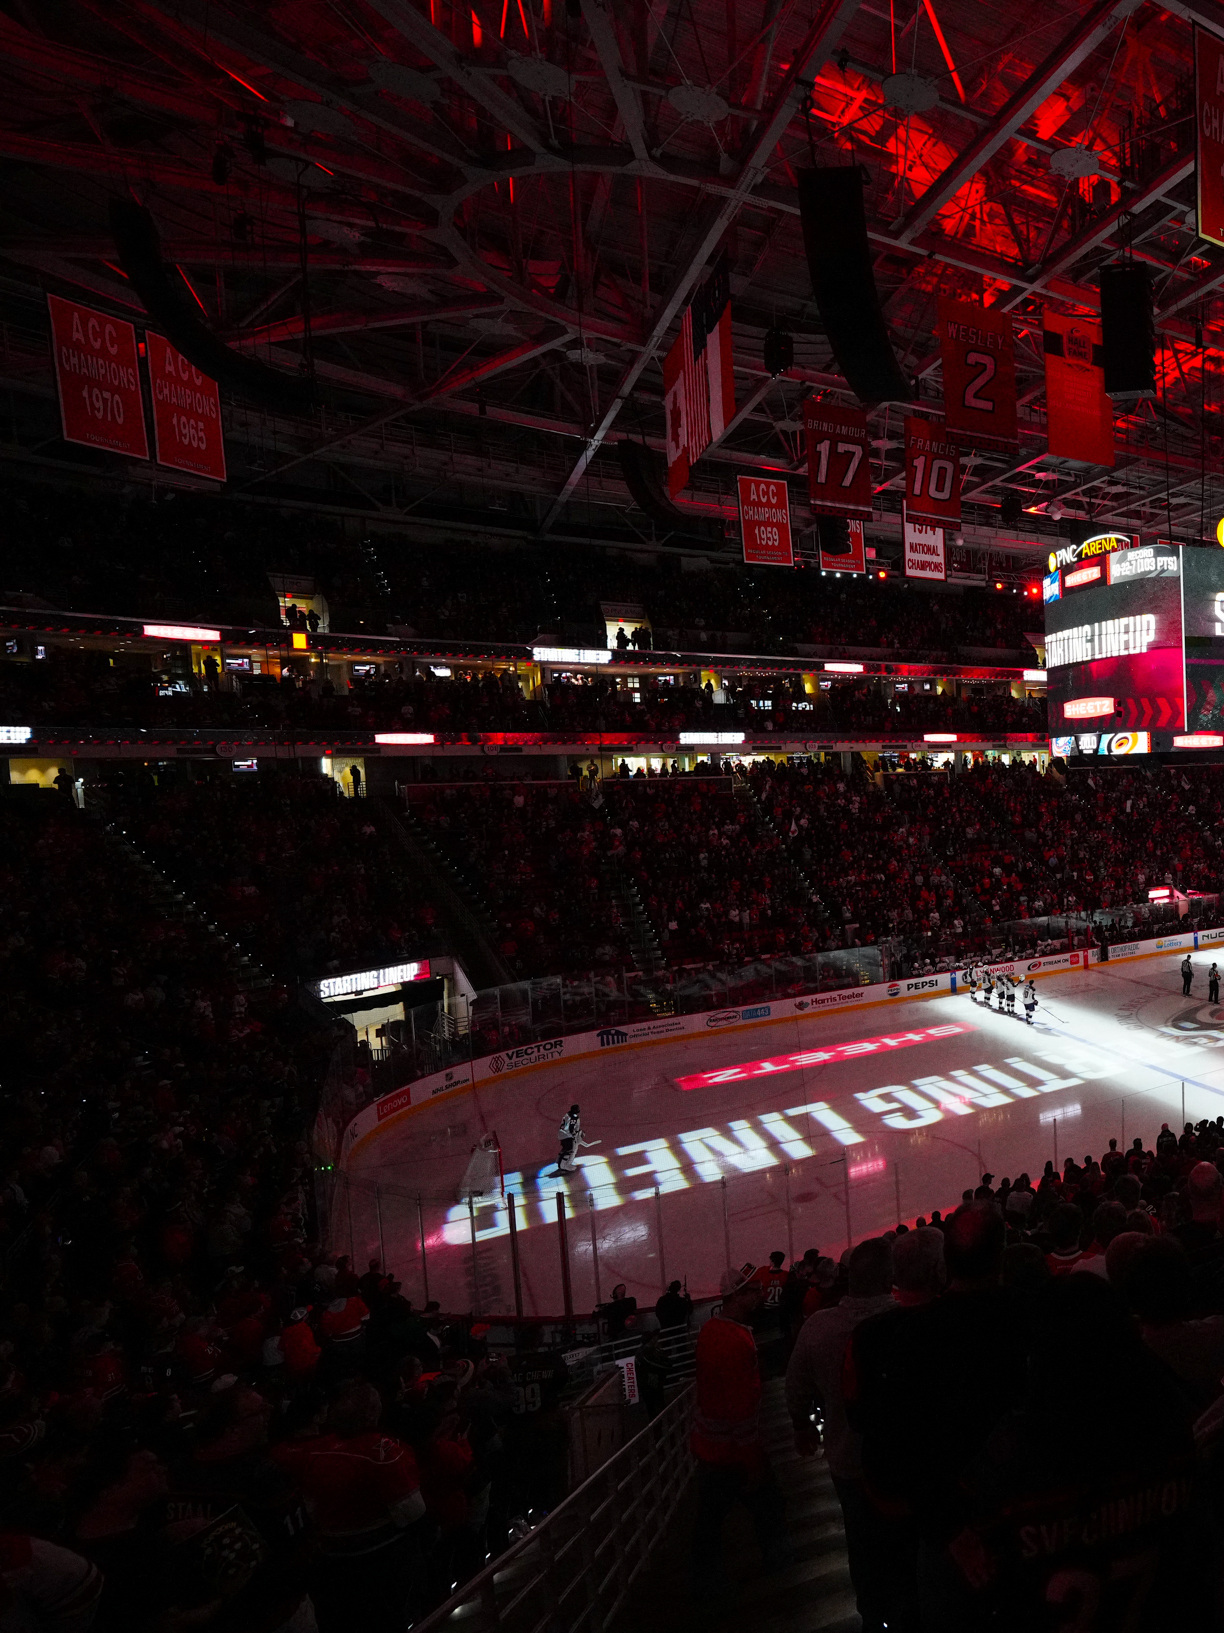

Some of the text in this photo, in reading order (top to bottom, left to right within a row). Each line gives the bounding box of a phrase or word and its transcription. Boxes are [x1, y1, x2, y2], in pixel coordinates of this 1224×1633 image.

[72, 311, 118, 355] ACC
[947, 321, 1005, 351] WESLEY
[61, 346, 136, 391] CHAMPIONS
[964, 351, 996, 413] 2
[81, 384, 124, 425] 1970
[155, 378, 217, 419] CHAMPIONS
[172, 412, 207, 450] 1965
[806, 418, 867, 439] BRIND'AMOUR
[86, 432, 131, 449] TOURNAMENT
[909, 436, 957, 456] FRANCIS
[815, 439, 864, 487] 17
[912, 454, 955, 500] 10
[750, 482, 778, 504] ACC
[743, 505, 788, 524] CHAMPIONS
[755, 525, 779, 546] 1959
[909, 542, 940, 557] NATIONAL
[1055, 536, 1118, 567] PNC ARENA
[1127, 548, 1153, 561] RECORD
[907, 559, 943, 574] CHAMPIONS
[1157, 556, 1178, 571] PTS)
[1066, 569, 1098, 585] SHEETZ
[1094, 614, 1156, 659] LINEUP
[1065, 700, 1111, 716] SHEETZ
[1176, 736, 1222, 747] SHEETZ
[1110, 943, 1140, 954] ORTHOPAEDIC
[1164, 940, 1182, 948] Lottery
[1043, 959, 1062, 967] STREAM
[320, 962, 419, 998] STARTING LINEUP
[907, 980, 938, 991] PEPSI
[811, 996, 837, 1006] Harris
[837, 992, 864, 1002] Teeter
[742, 1008, 769, 1019] DATA443
[629, 1031, 650, 1039] Official
[652, 1021, 681, 1029] Associates
[505, 1039, 564, 1058] VECTOR
[702, 1025, 964, 1082] SHEETZ
[506, 1050, 564, 1071] SECURITY
[379, 1094, 408, 1116] Lenovo
[445, 1101, 864, 1246] LINEUP
[767, 1286, 783, 1303] 20
[625, 1362, 637, 1399] CHEATERS
[283, 1505, 305, 1537] 11
